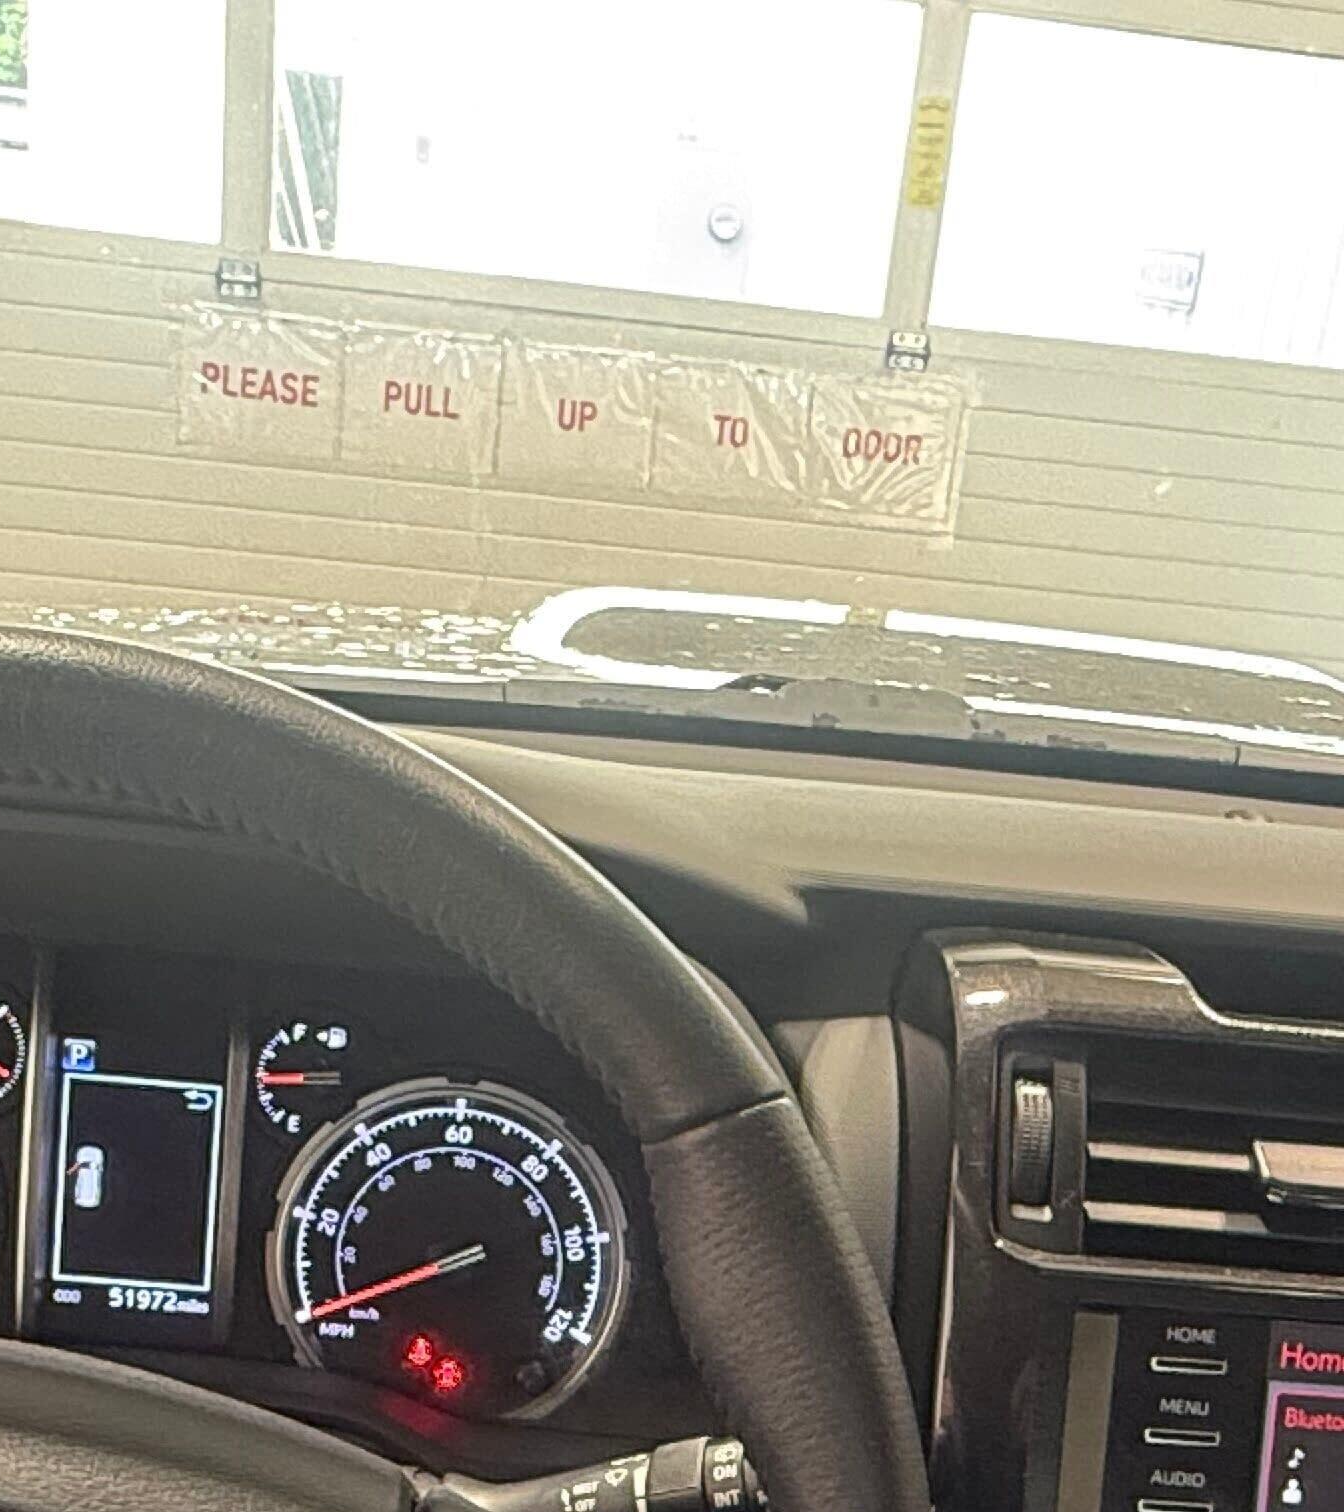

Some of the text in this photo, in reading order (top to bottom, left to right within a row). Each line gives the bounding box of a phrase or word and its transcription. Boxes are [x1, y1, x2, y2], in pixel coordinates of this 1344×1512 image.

[200, 361, 321, 408] PLEASE
[383, 380, 460, 421] PULL
[556, 398, 599, 434] UP
[713, 415, 751, 450] TO
[70, 1043, 89, 1067] P
[444, 1125, 474, 1145] 60
[365, 1142, 393, 1167] 40
[520, 1154, 549, 1182] 80
[316, 1209, 340, 1237] 20
[564, 1224, 586, 1262] 100
[543, 1307, 574, 1343] 120
[1166, 1326, 1217, 1345] HOME
[1159, 1398, 1210, 1416] MENU
[712, 1463, 738, 1482] ON
[1150, 1468, 1206, 1488] AUDIO
